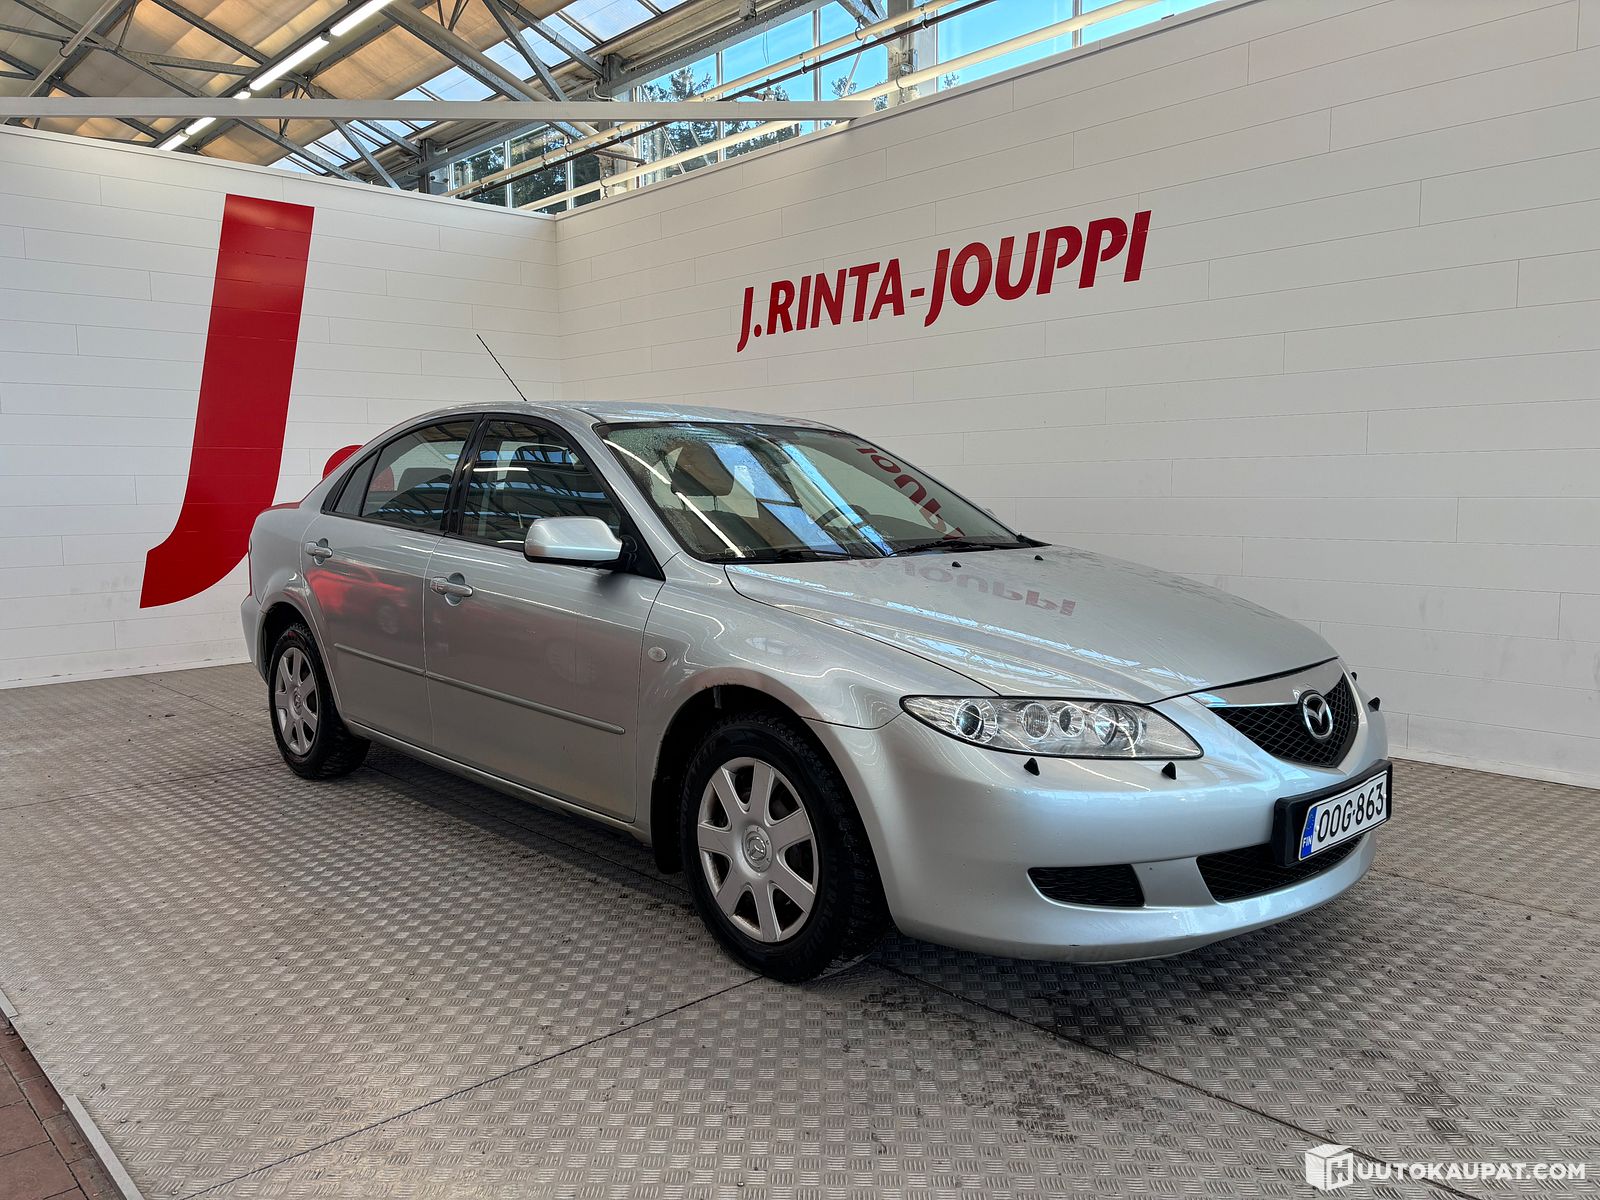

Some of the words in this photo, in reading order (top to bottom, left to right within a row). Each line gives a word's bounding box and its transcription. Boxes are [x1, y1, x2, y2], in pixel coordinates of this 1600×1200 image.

[737, 210, 1152, 353] J.RINTA-JOUPPI
[1303, 835, 1312, 847] FIN
[1318, 783, 1383, 842] OOG-863
